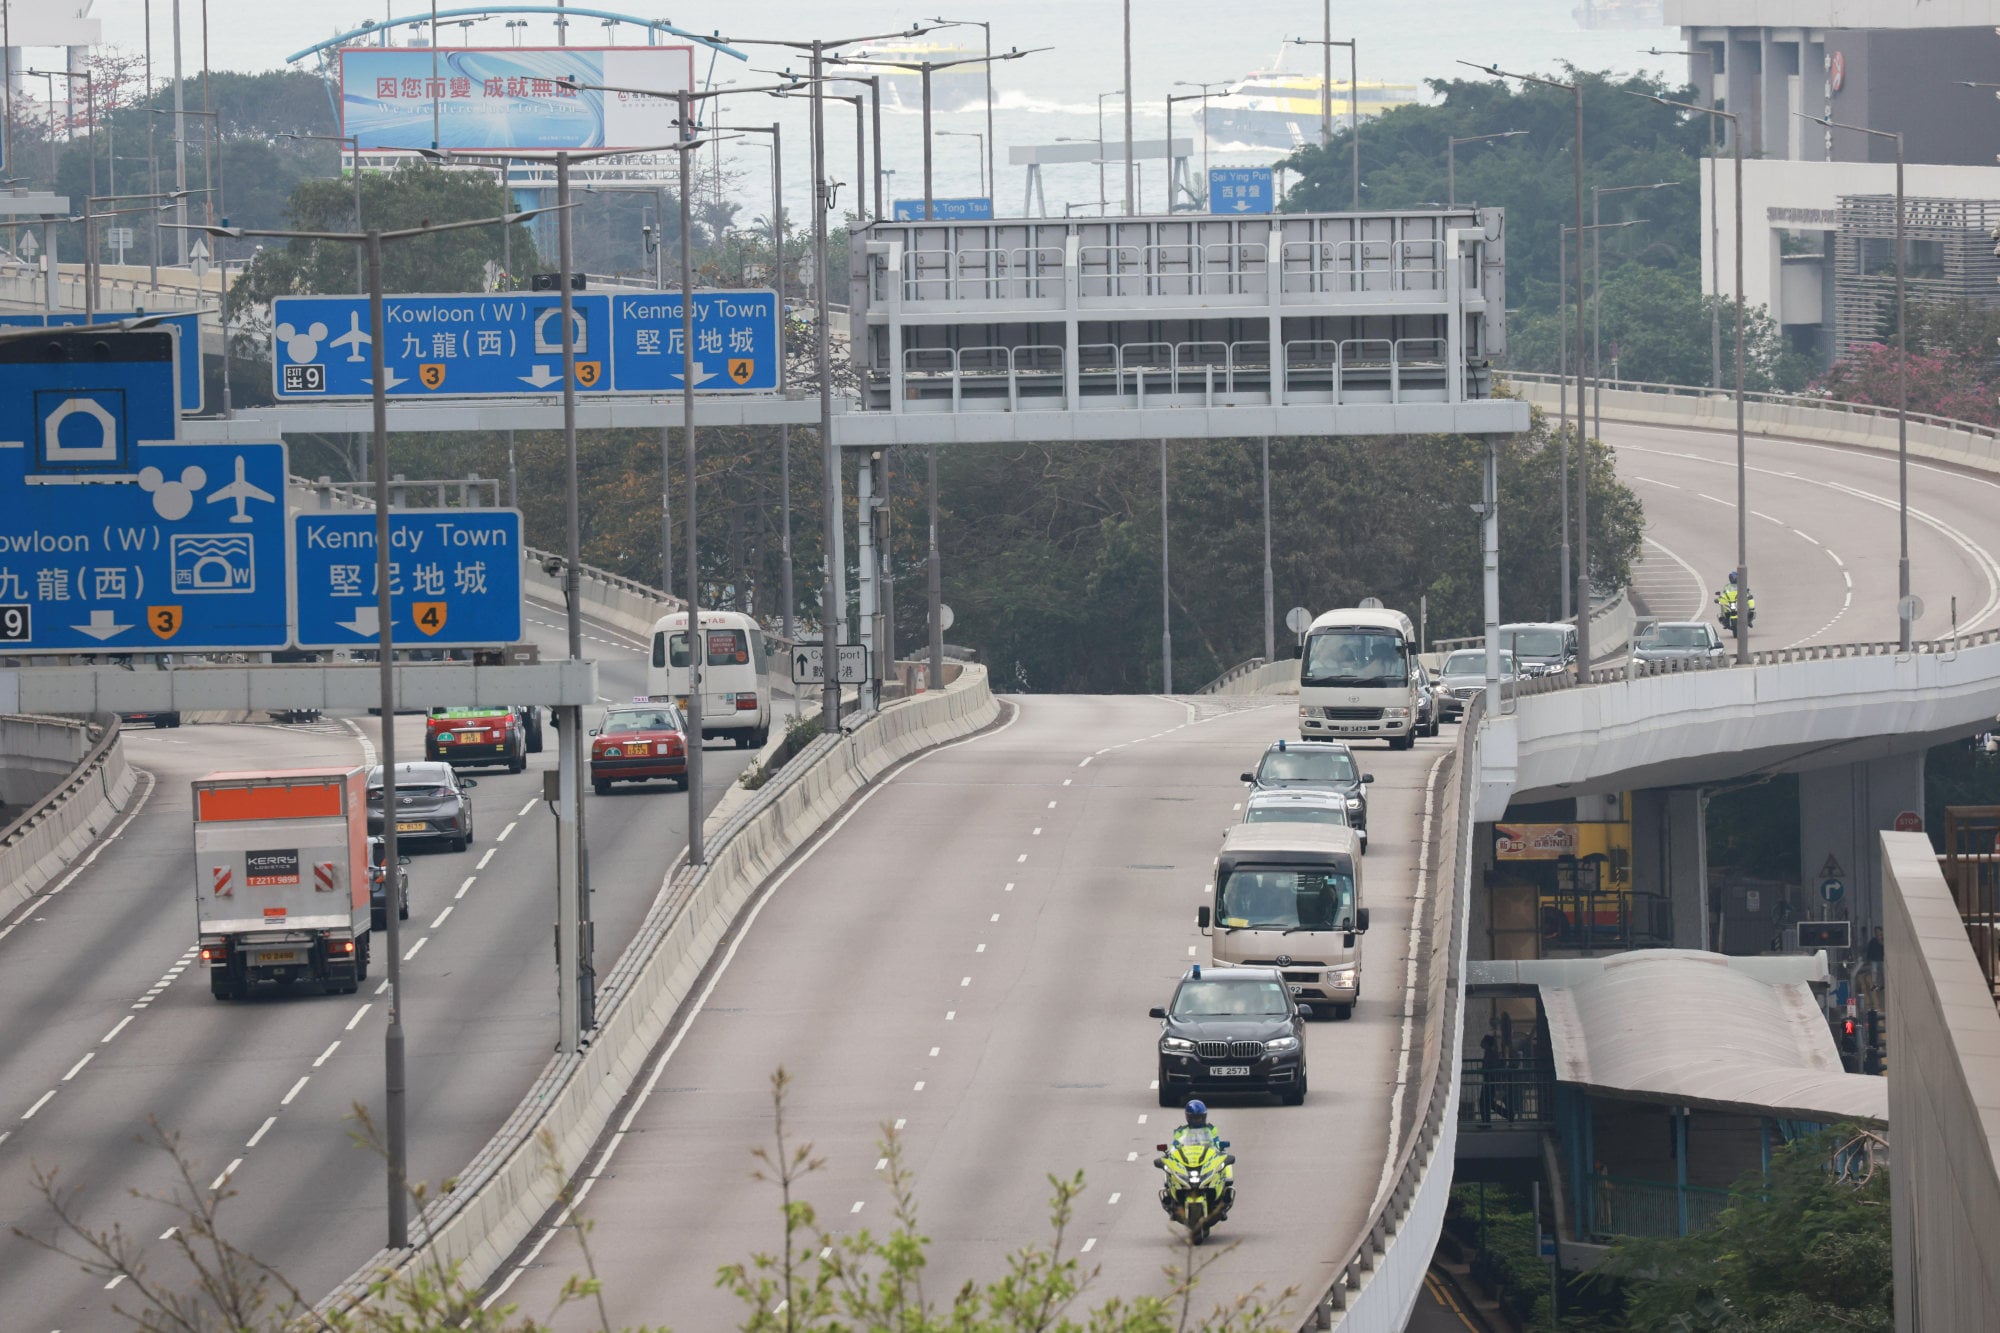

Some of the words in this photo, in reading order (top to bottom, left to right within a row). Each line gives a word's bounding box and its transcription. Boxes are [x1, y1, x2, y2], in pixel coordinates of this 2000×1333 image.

[376, 76, 471, 99] 因您而變
[483, 75, 577, 98] 成就無限
[1211, 171, 1226, 182] Sai
[1230, 171, 1249, 183] Ying
[1252, 170, 1270, 180] Pun
[942, 203, 966, 215] Tong
[967, 201, 988, 212] Tsui
[386, 304, 475, 324] Kowloon
[480, 302, 526, 322] (W)
[623, 301, 710, 322] Kennedy
[713, 299, 768, 320] Town
[401, 329, 516, 359] 九龍(西)
[636, 327, 755, 356] 堅尼地城
[287, 367, 302, 377] EXIT
[306, 367, 320, 389] 9
[426, 367, 440, 386] 3
[581, 364, 595, 383] 3
[733, 361, 749, 379] 4
[287, 376, 303, 389] 出
[0, 531, 90, 553] owloon
[103, 525, 160, 551] (W)
[307, 525, 424, 553] Kenndy
[435, 523, 508, 547] Town
[0, 565, 145, 602] 九龍(西)
[176, 569, 193, 585] 西
[232, 567, 250, 584] W
[329, 560, 488, 598] 堅尼地城
[4, 609, 23, 637] 9
[156, 610, 174, 633] 3
[420, 606, 440, 628] 4
[810, 650, 860, 661] Cyport
[812, 665, 854, 679] 數港
[248, 856, 297, 865] KERRY
[248, 877, 254, 885] T
[255, 875, 276, 885] 2211
[1211, 1067, 1223, 1075] VE
[1226, 1067, 1248, 1075] 2573
